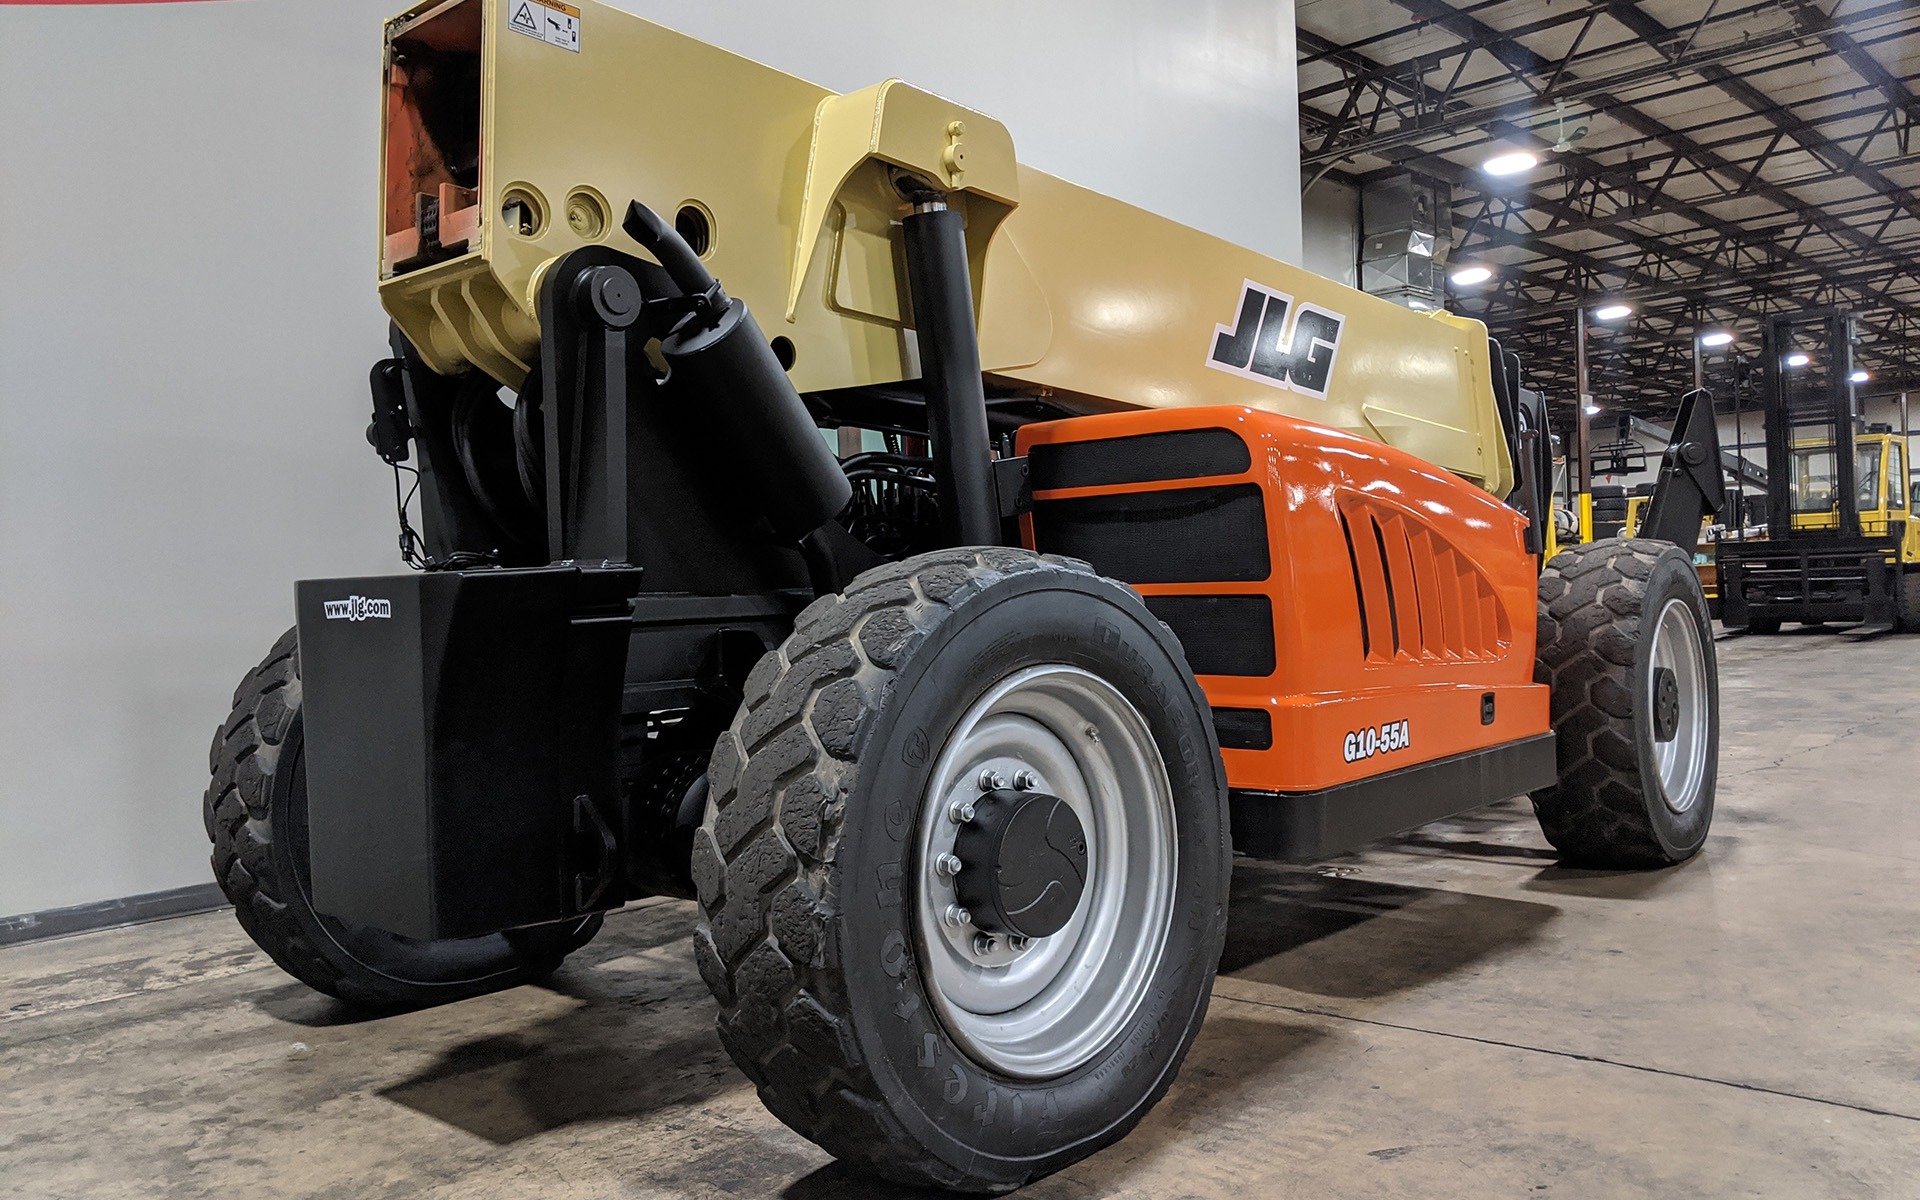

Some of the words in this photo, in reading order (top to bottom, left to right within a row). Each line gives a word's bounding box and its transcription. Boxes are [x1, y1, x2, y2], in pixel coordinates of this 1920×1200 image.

[1212, 287, 1341, 393] JLG
[325, 597, 389, 619] www.jlg.com
[1343, 718, 1410, 764] G10-55A
[876, 798, 1067, 1136] Firestone
